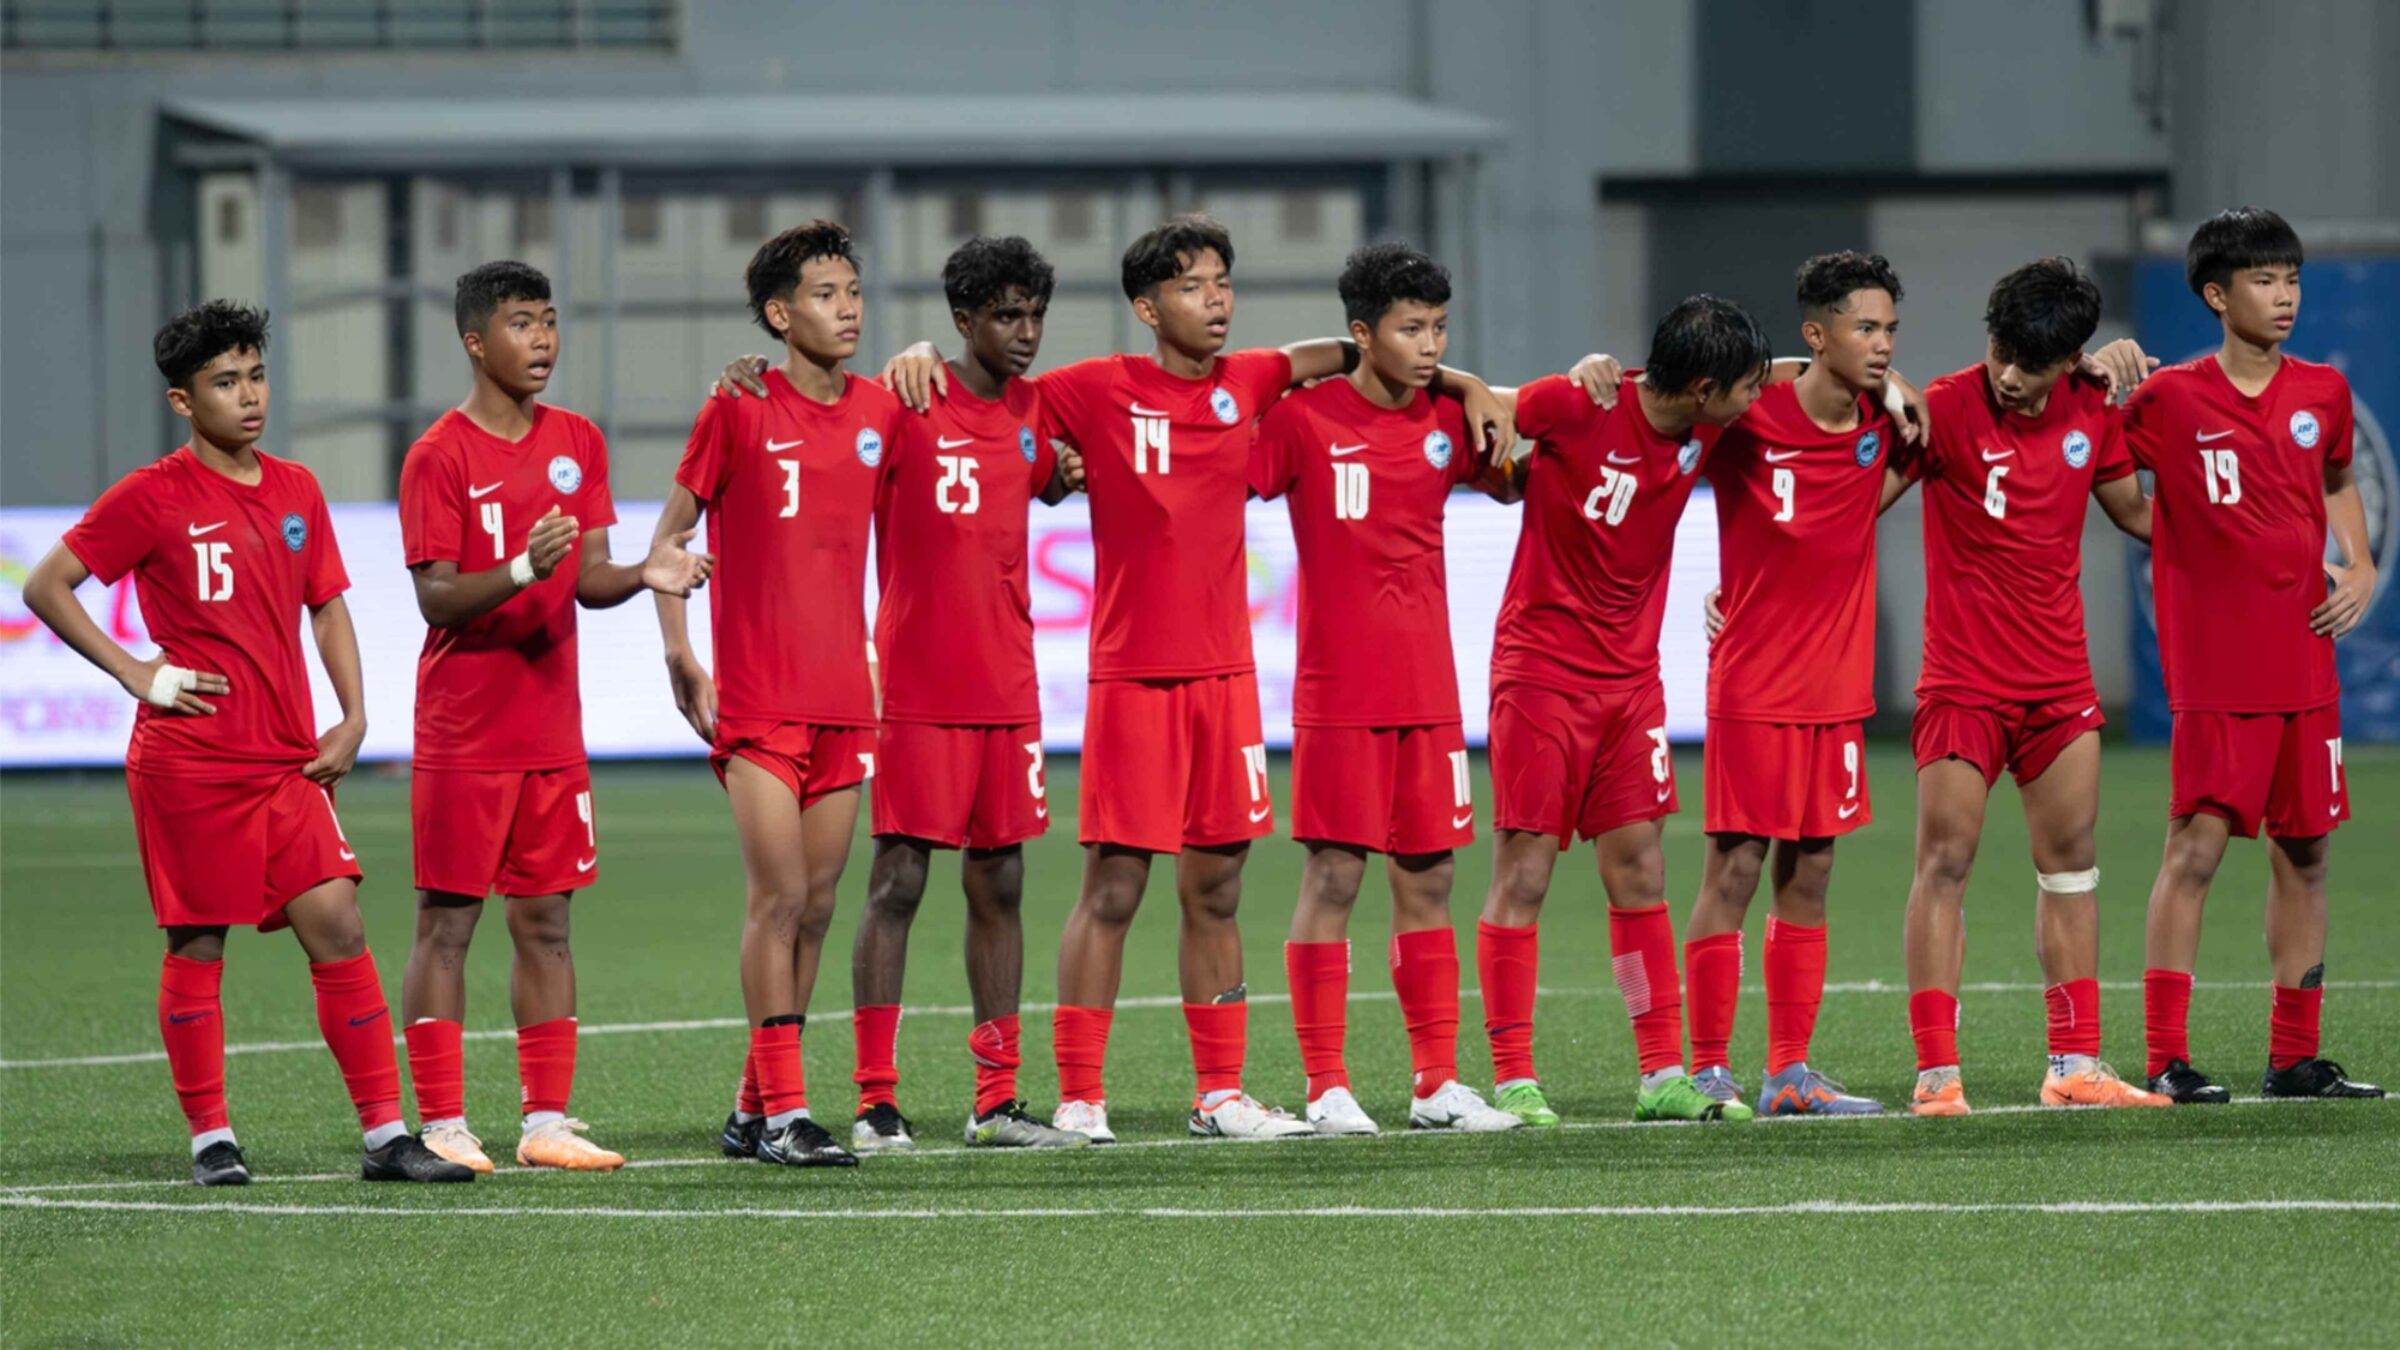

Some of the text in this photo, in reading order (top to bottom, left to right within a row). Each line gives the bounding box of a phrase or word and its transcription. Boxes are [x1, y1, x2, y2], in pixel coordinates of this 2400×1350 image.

[1131, 417, 1170, 475] 14
[777, 458, 800, 518] 3
[935, 455, 980, 515] 25
[1332, 462, 1370, 521] 10
[1583, 465, 1638, 527] 20
[1772, 468, 1795, 524] 9
[1984, 465, 2009, 520] 6
[2200, 449, 2242, 505] 19
[480, 502, 505, 560] 4
[192, 542, 234, 602] 15
[1843, 741, 1859, 800] 9
[575, 790, 595, 848] 4
